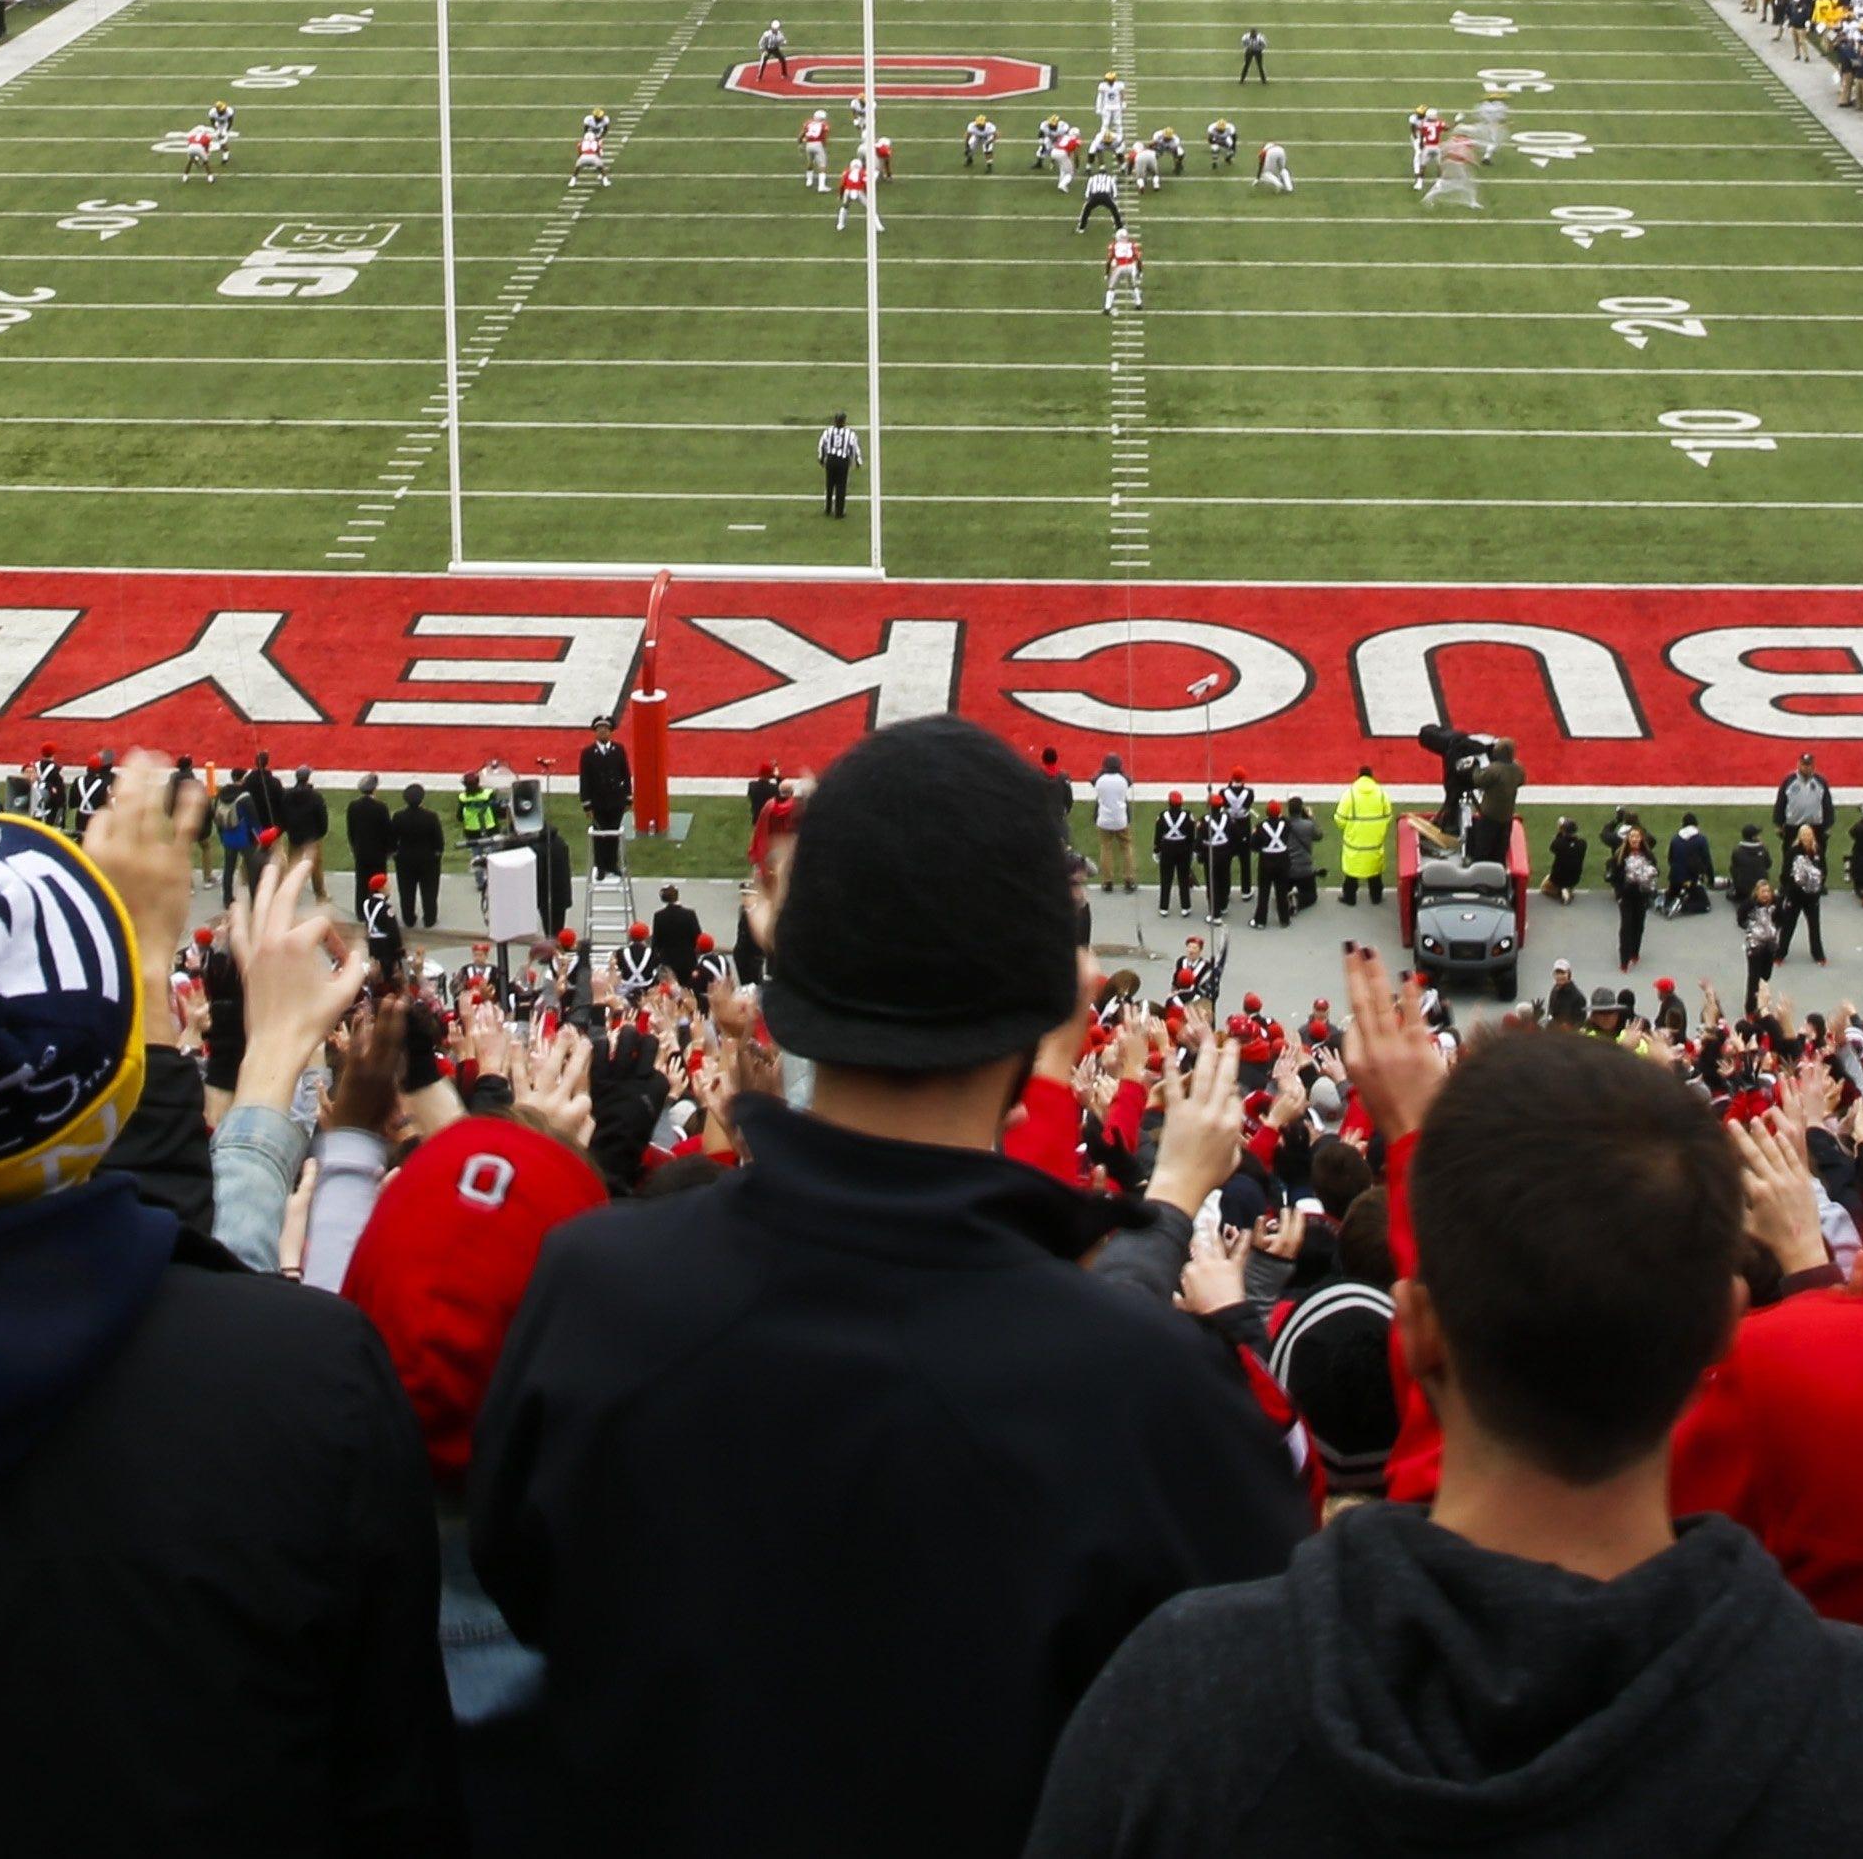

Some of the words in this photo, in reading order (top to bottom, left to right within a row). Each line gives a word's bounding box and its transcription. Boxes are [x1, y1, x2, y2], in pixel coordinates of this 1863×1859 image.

[230, 64, 318, 90] 50
[1476, 68, 1556, 93] 50
[56, 198, 159, 231] 30
[1549, 204, 1646, 240] 30
[1597, 295, 1708, 338] 20
[1656, 408, 1779, 451] 10
[456, 1152, 516, 1208] O
